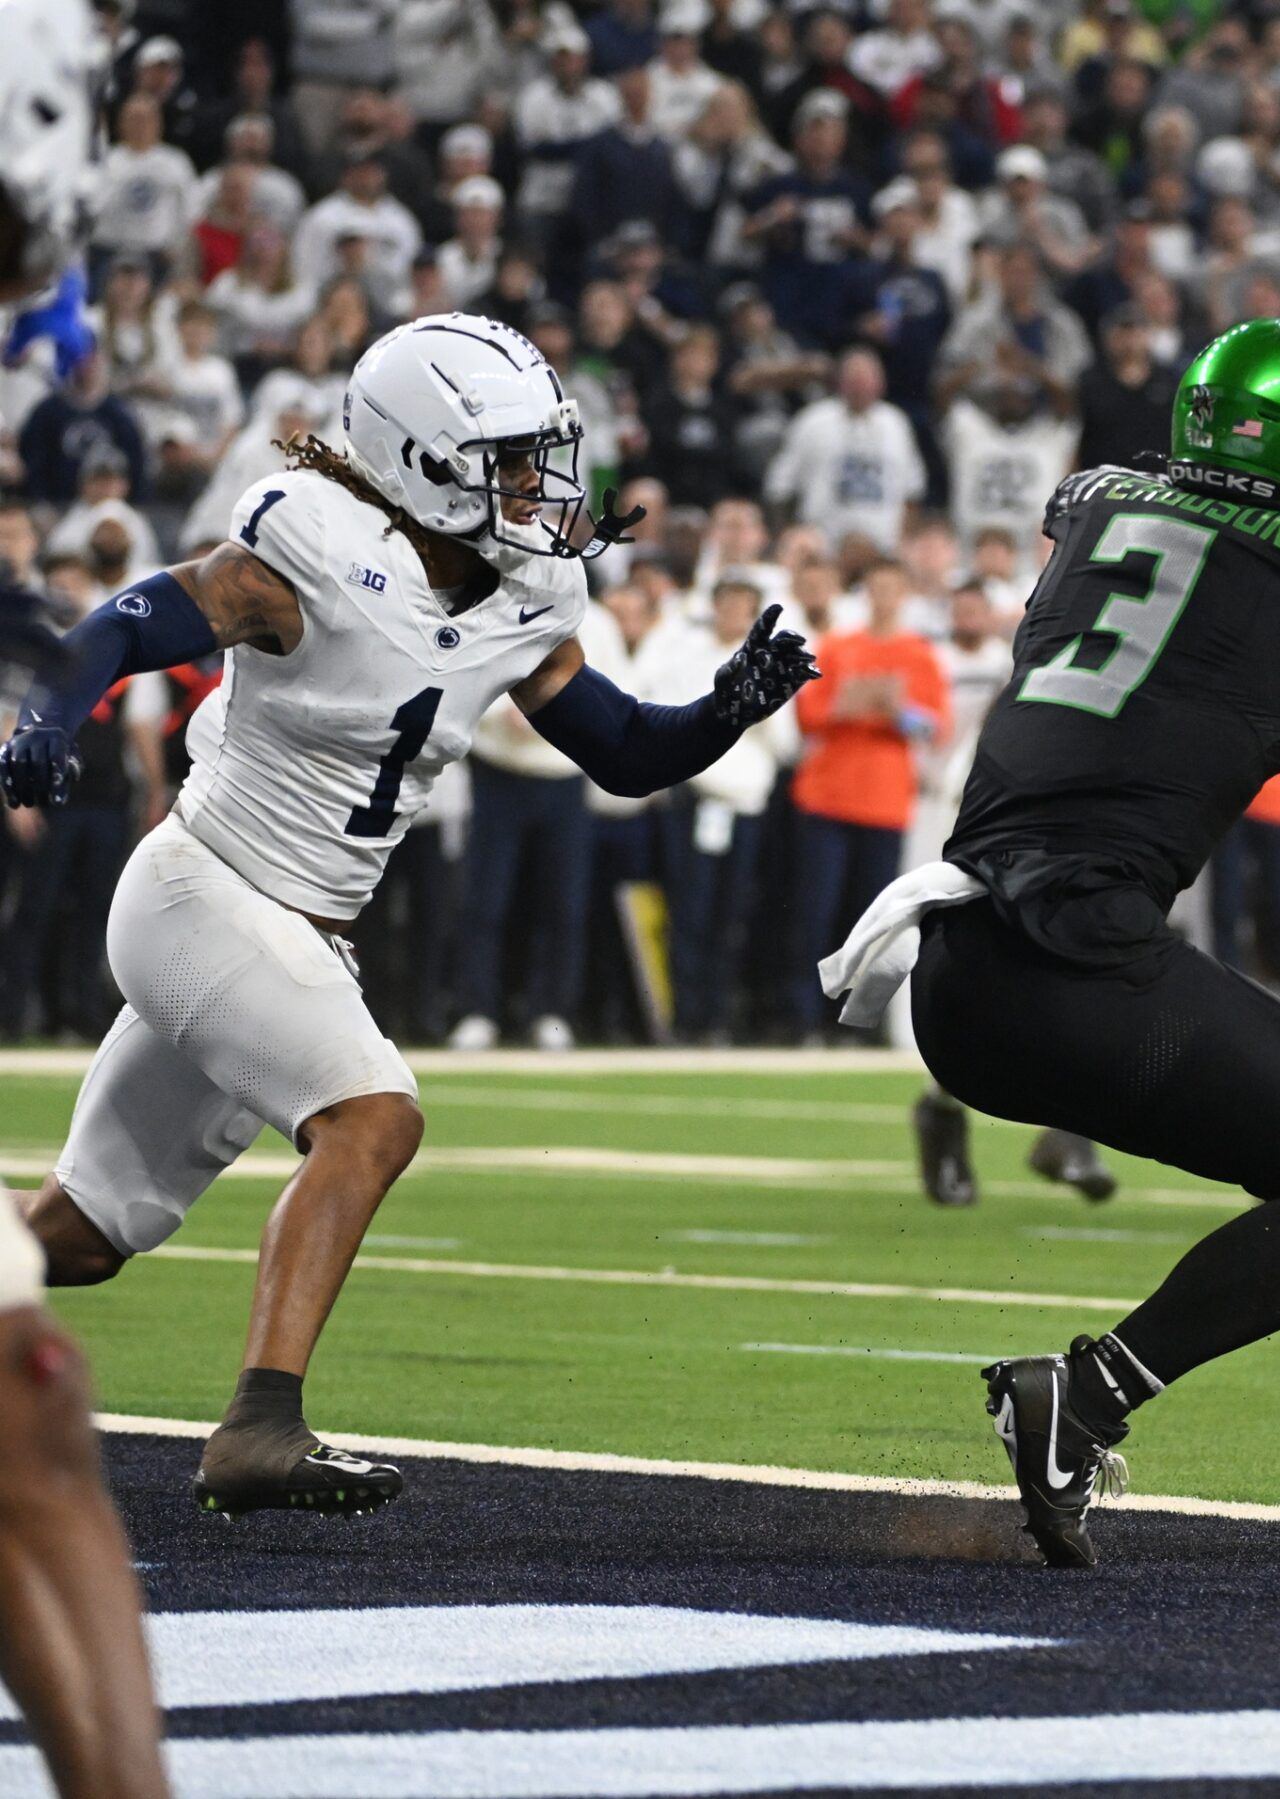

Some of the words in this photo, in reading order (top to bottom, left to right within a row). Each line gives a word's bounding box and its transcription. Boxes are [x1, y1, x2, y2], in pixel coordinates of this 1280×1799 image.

[240, 490, 287, 548] 1
[1171, 465, 1276, 498] DUCKS
[1015, 513, 1219, 718] 3
[344, 686, 445, 838] 1
